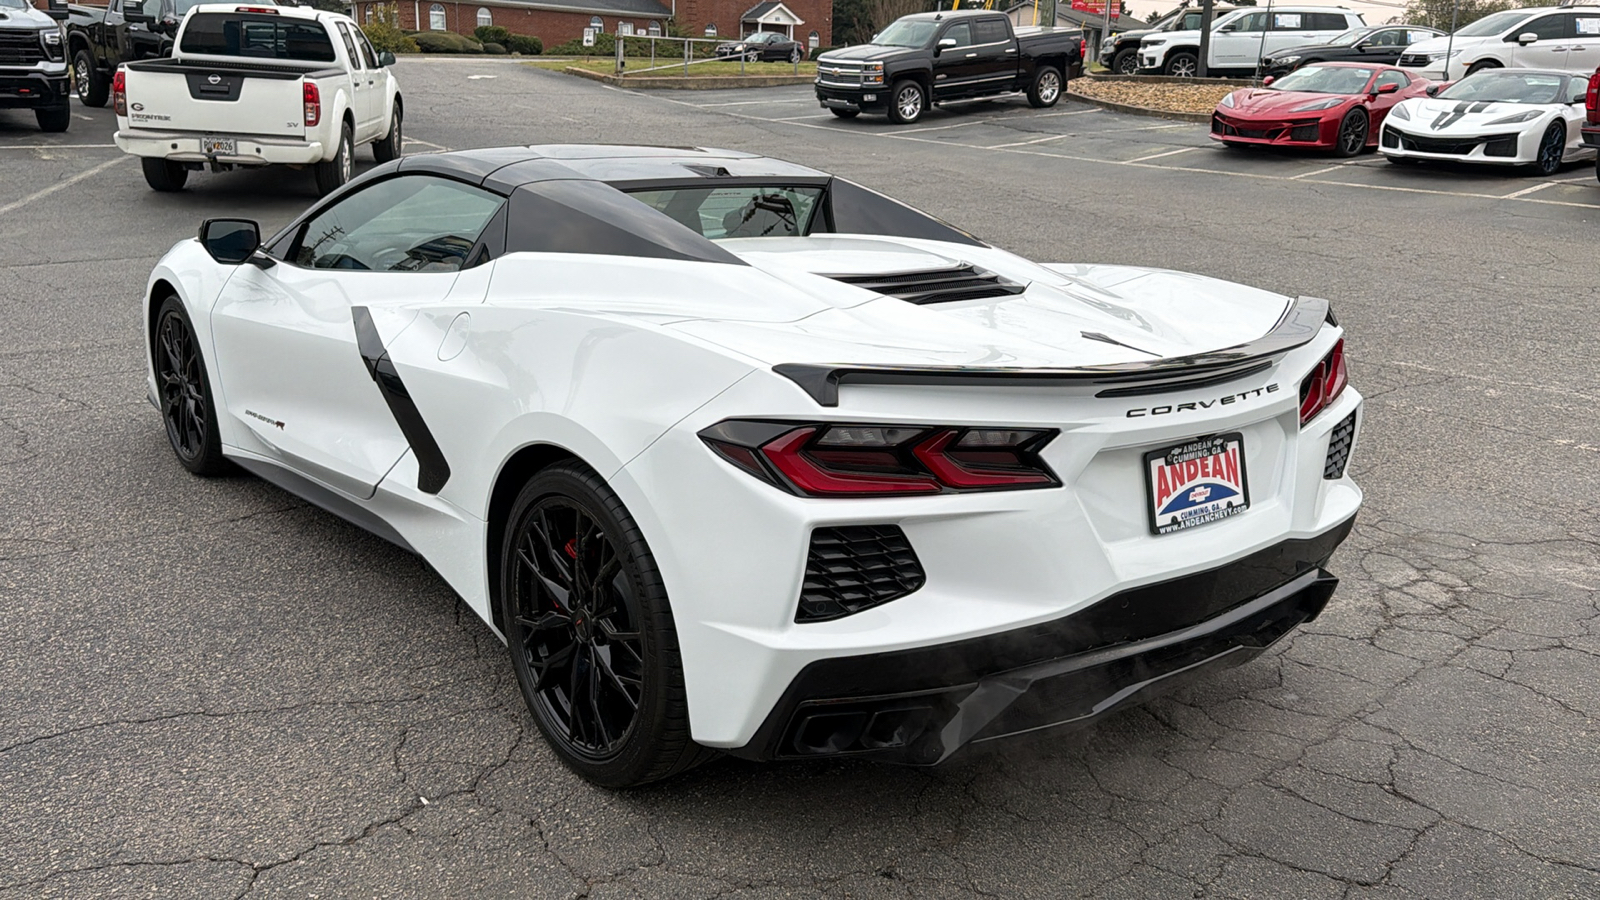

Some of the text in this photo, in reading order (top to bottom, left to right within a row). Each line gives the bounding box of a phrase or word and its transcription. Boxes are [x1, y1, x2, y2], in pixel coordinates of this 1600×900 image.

[1126, 383, 1280, 418] CORVETTE
[1173, 446, 1222, 464] CUMMING, GA
[1182, 440, 1212, 453] ANDEAN
[1157, 447, 1240, 509] ANDEAN
[1159, 504, 1248, 535] www.ANDEANCHEVY.com
